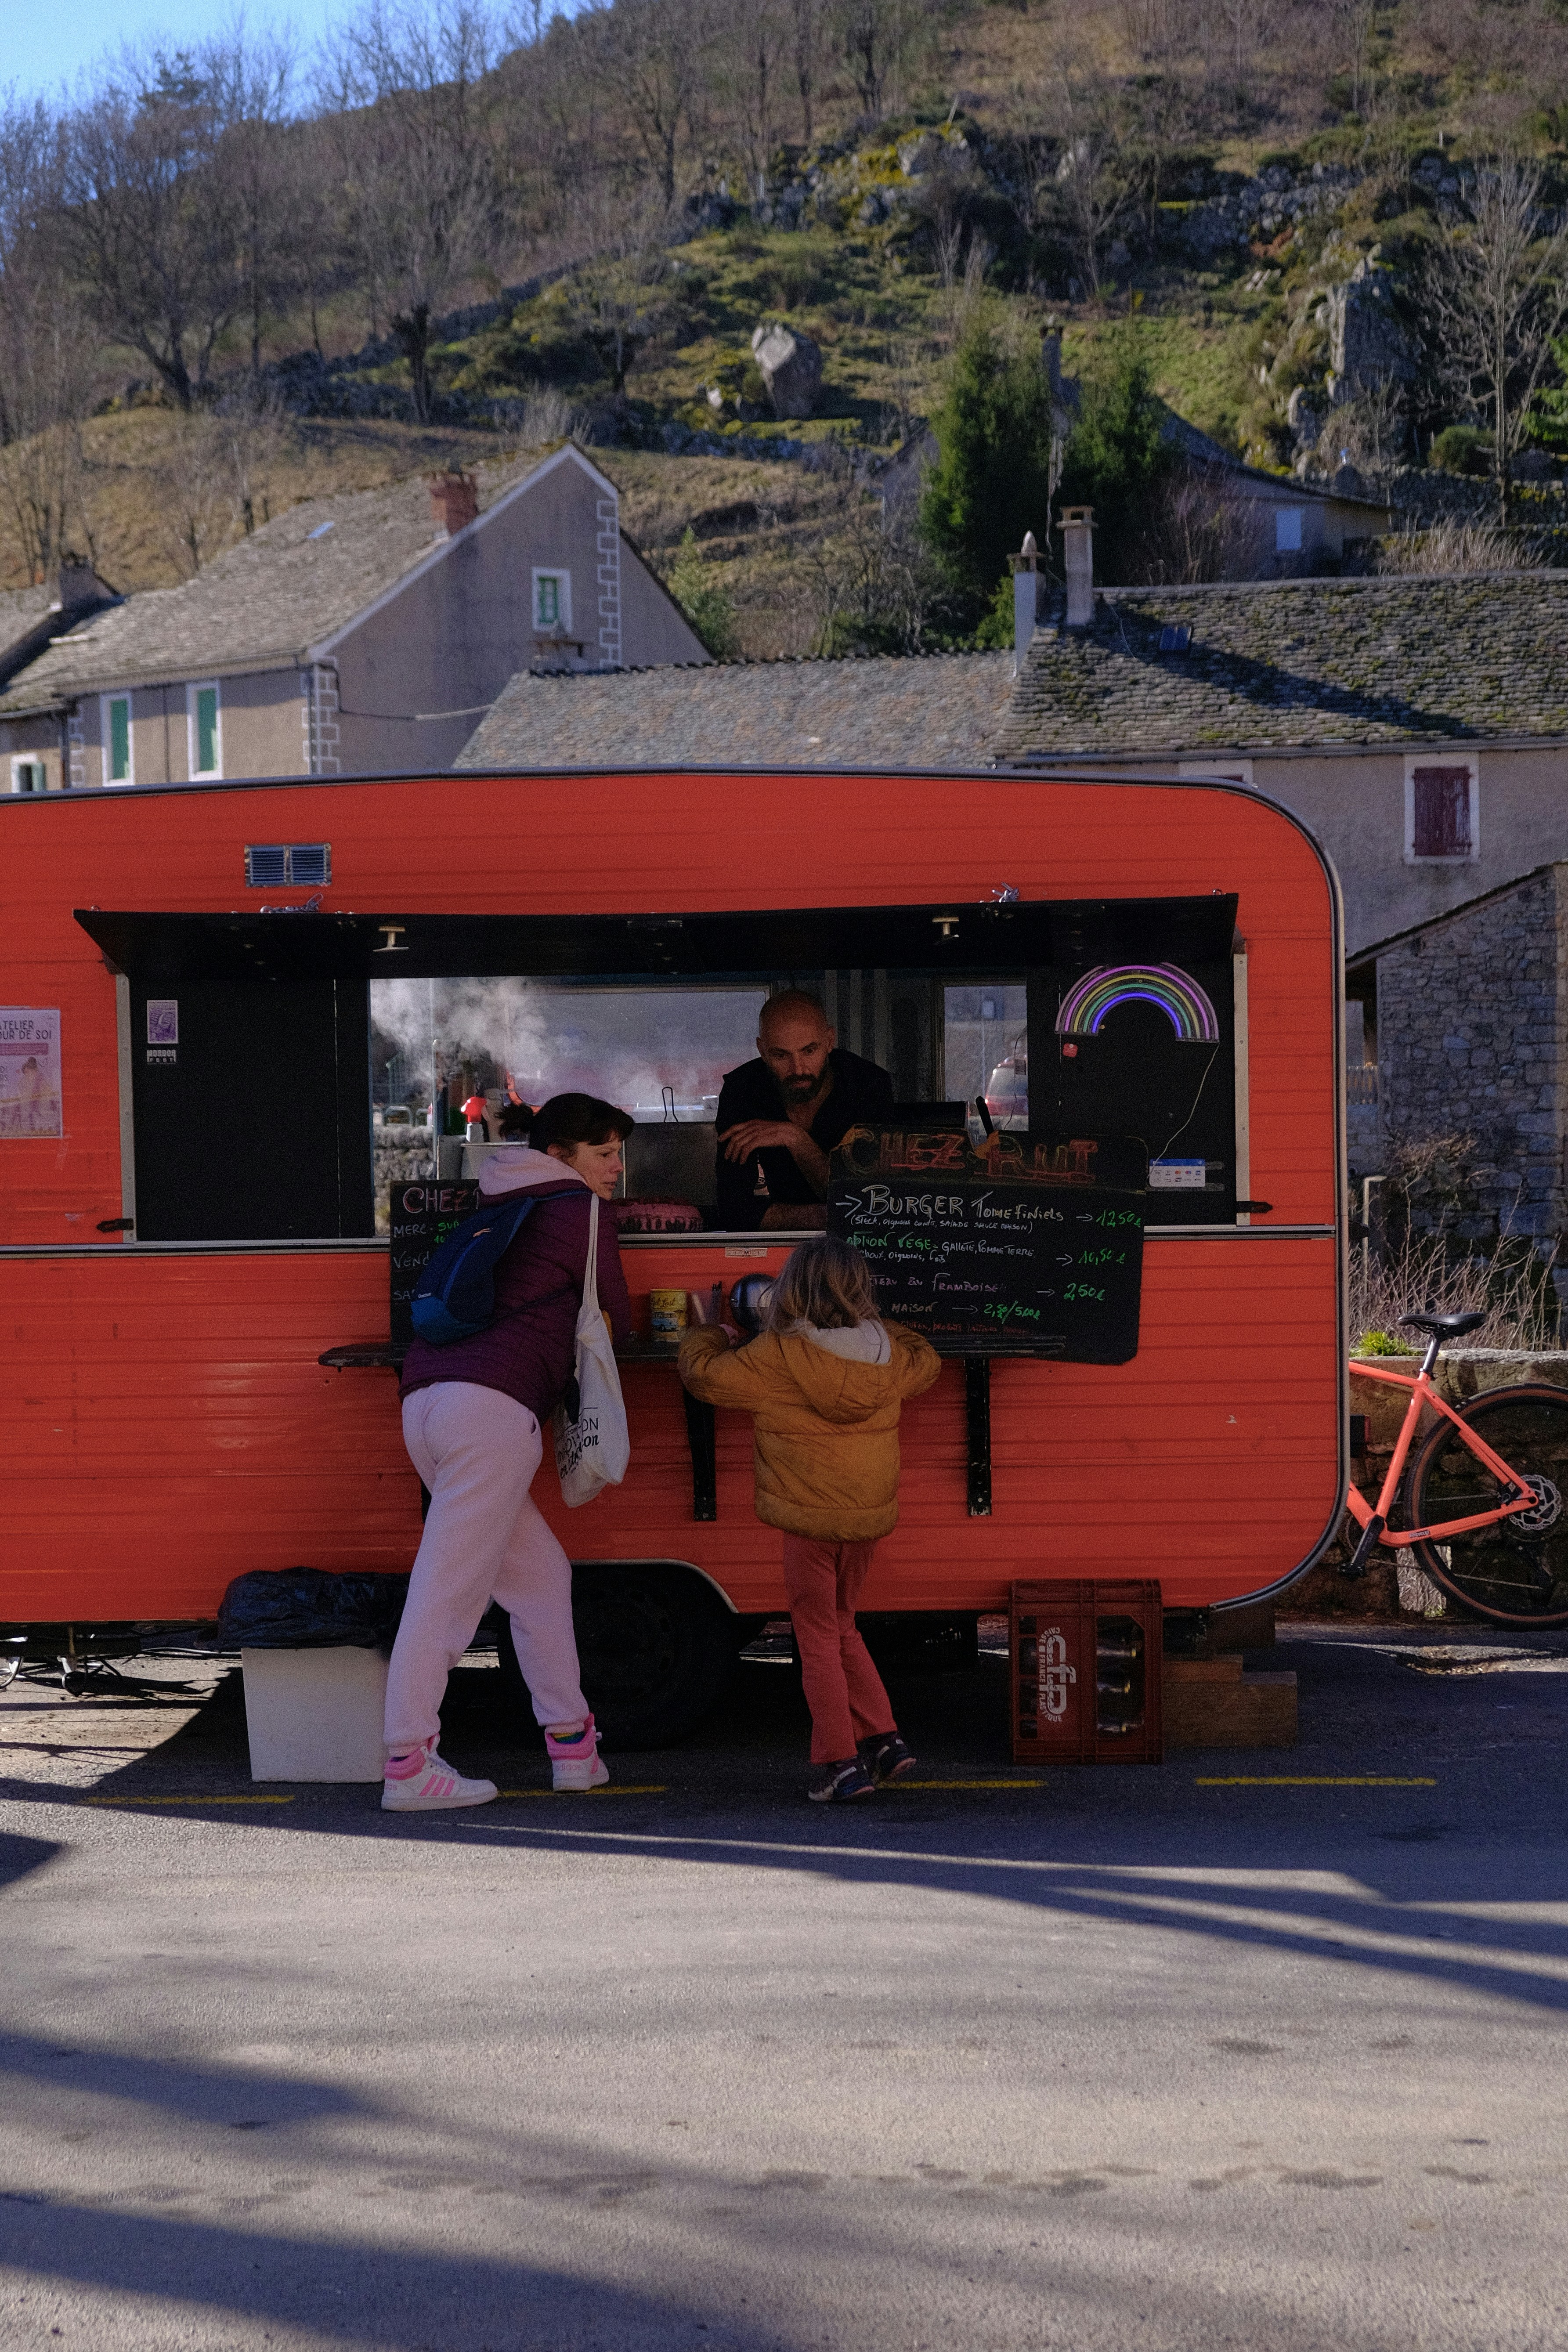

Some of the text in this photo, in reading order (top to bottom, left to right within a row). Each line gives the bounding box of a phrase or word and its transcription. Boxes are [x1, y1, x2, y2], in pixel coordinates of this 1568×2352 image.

[19, 1030, 31, 1039] DE
[36, 1030, 51, 1039] SOI
[841, 1126, 965, 1174] CHEZ
[403, 1187, 469, 1214] CHEZ
[861, 1184, 964, 1220] BURGER
